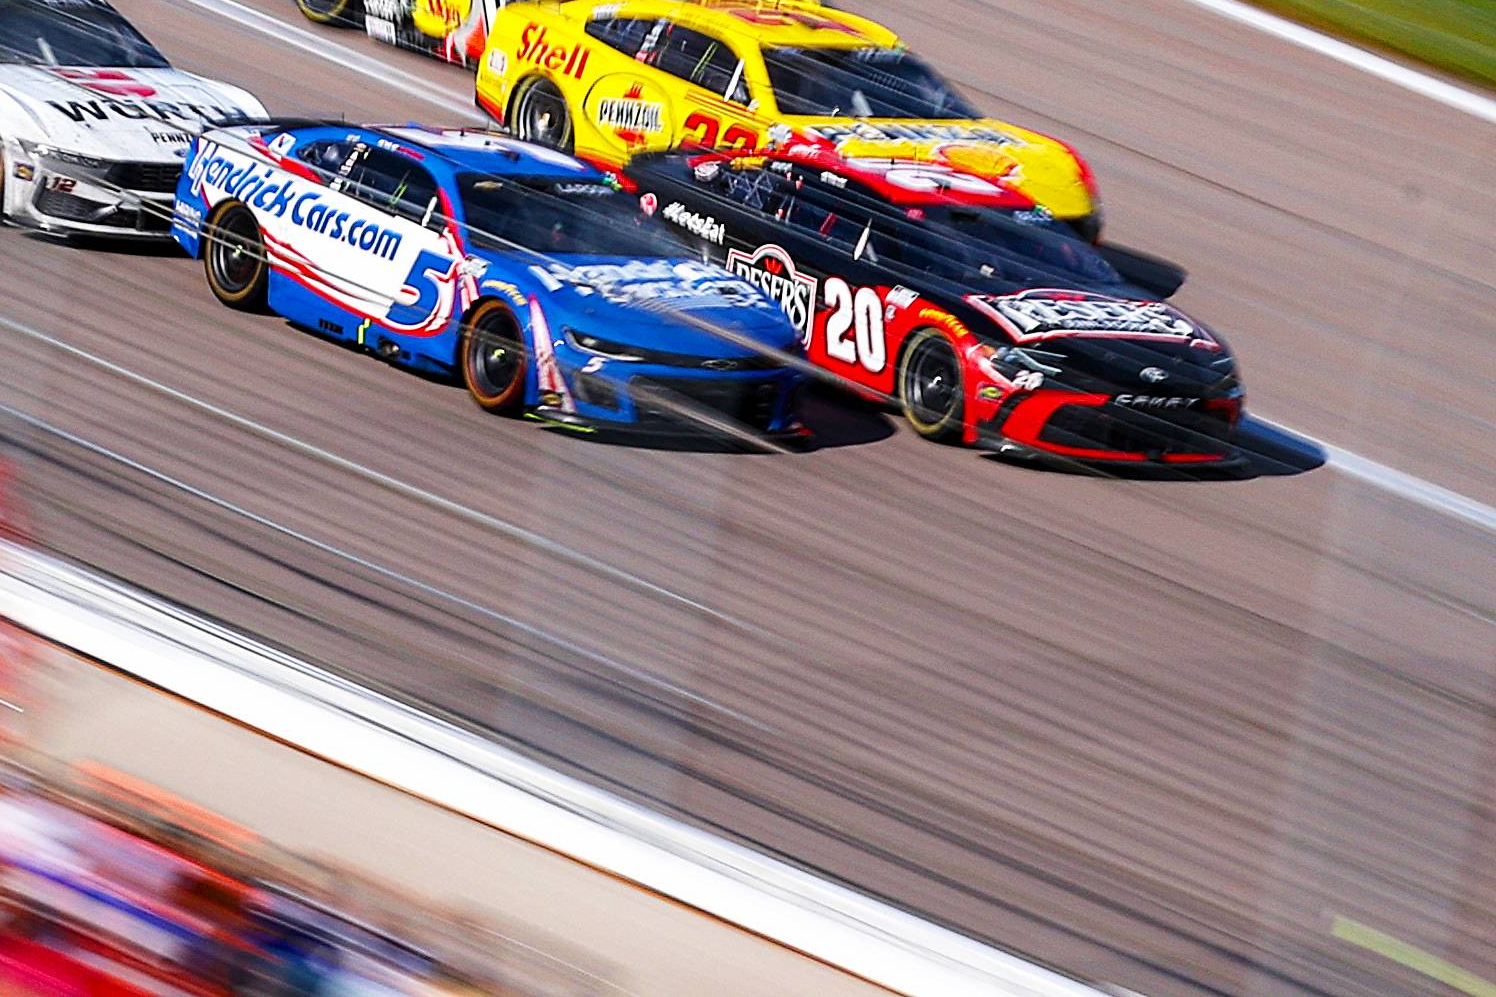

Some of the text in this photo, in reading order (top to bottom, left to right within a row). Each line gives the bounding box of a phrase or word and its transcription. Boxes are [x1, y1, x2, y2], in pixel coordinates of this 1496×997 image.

[516, 21, 590, 80] Shell
[150, 132, 192, 145] PENNZ
[598, 99, 665, 132] PENNZOIL
[55, 176, 78, 193] 12
[386, 248, 454, 327] 5
[824, 276, 887, 374] 20
